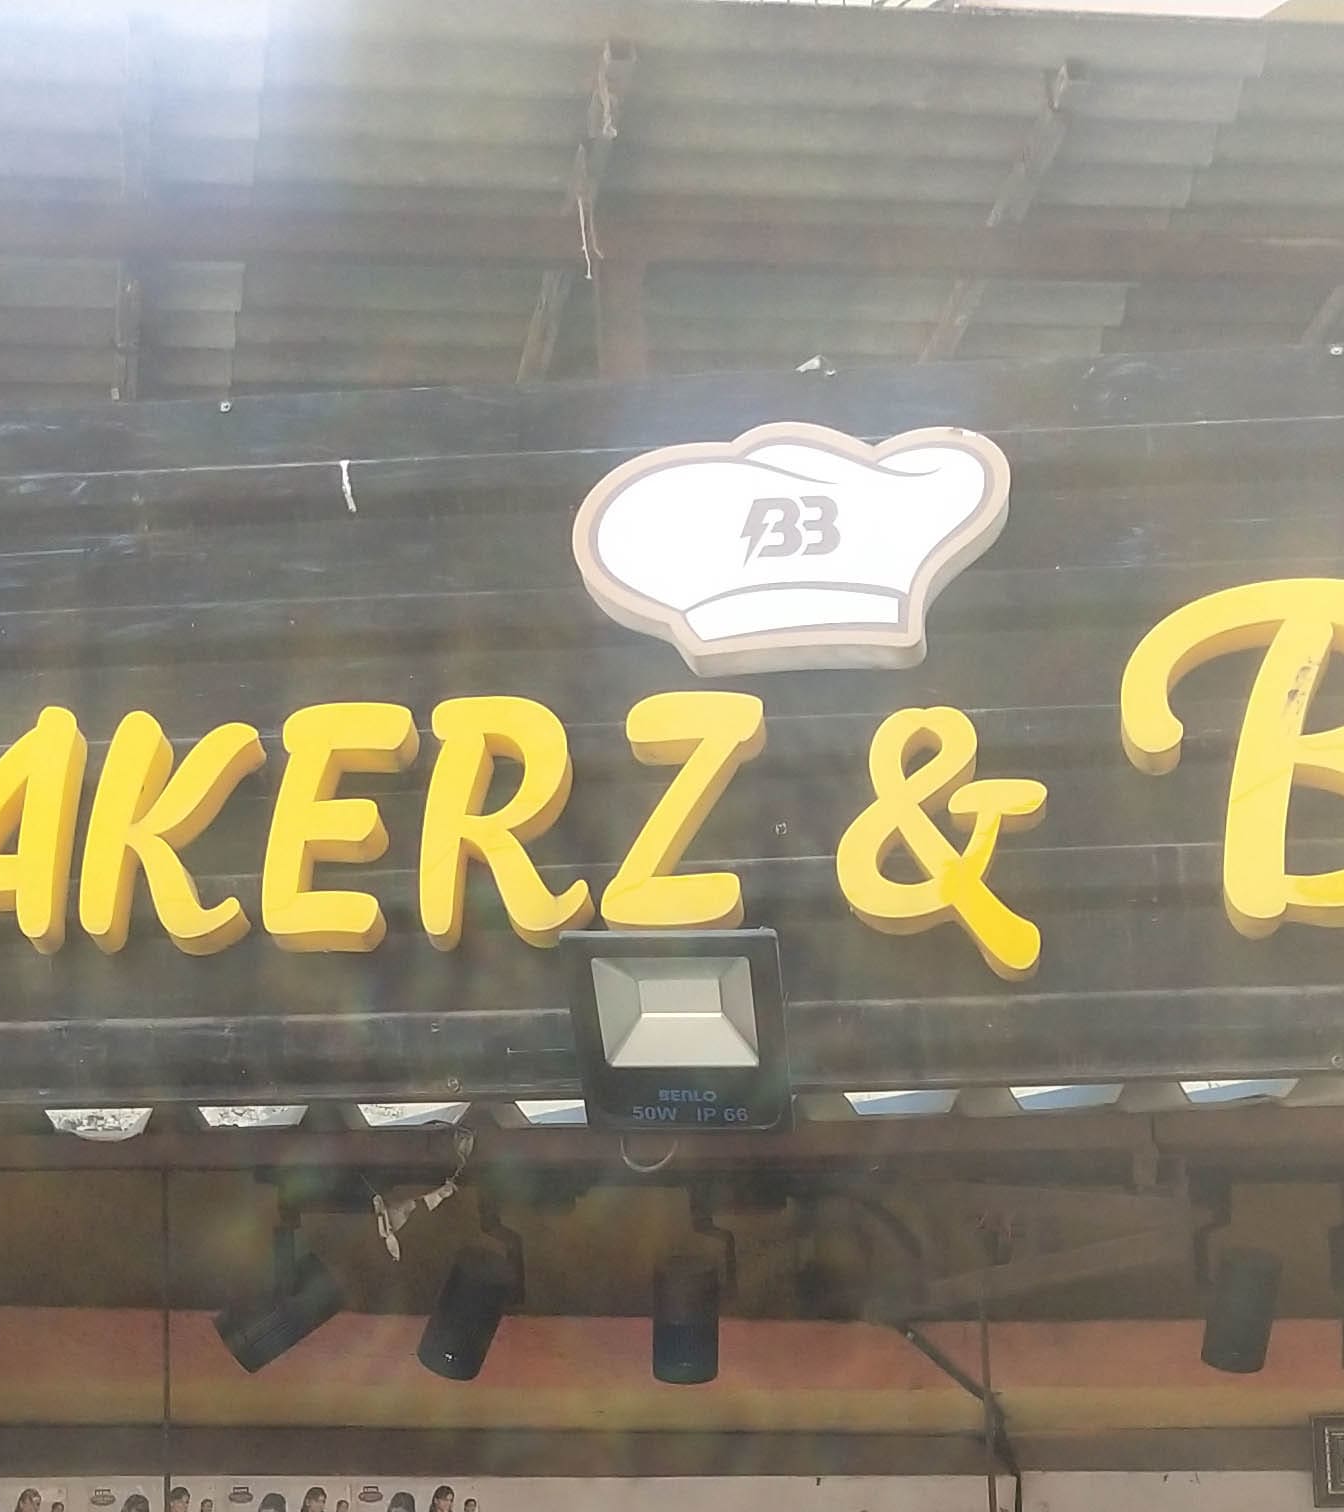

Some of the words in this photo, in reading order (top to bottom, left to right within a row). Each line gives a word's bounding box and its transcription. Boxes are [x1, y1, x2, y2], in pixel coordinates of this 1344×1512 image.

[836, 706, 1048, 981] &
[632, 1106, 677, 1121] 50W
[697, 1108, 717, 1121] IP
[723, 1108, 749, 1122] 66
